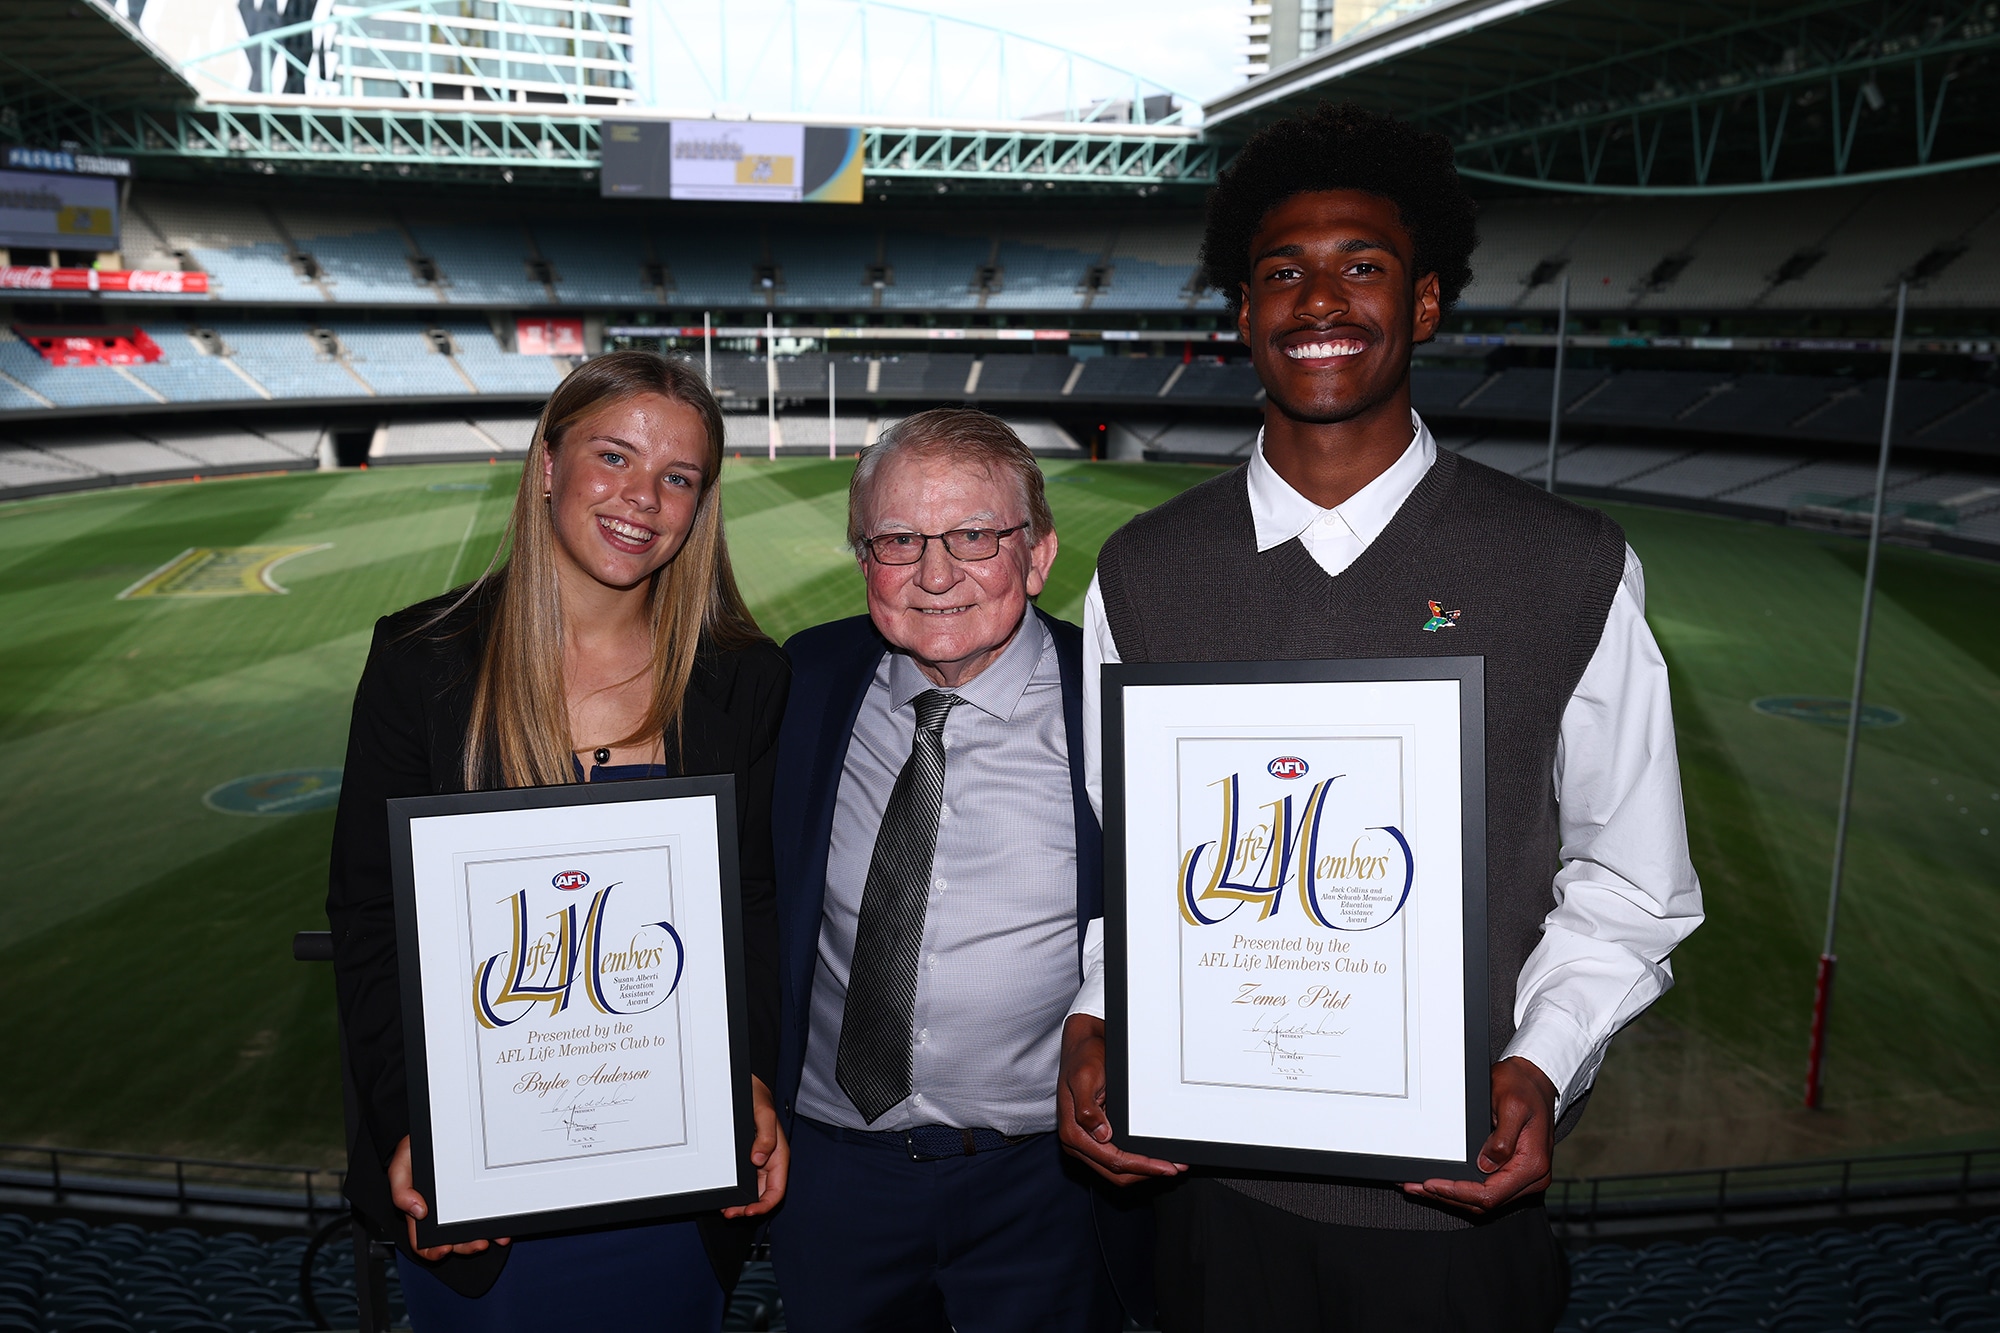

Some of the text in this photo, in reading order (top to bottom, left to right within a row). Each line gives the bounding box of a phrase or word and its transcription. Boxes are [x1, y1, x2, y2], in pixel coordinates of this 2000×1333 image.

[1270, 761, 1306, 775] AFL
[555, 874, 588, 887] AFL
[1346, 886, 1369, 894] Collins
[1231, 934, 1350, 955] Presented by the
[1198, 952, 1388, 974] AFL Life Members Club to
[613, 973, 659, 984] Susan Alberti
[619, 982, 654, 991] Education
[619, 990, 655, 999] Assistance
[626, 997, 649, 1006] Award
[1231, 982, 1352, 1010] Zemes Pilot
[527, 1022, 633, 1044] Presented by the
[496, 1036, 665, 1064] AFL Life Members Club to
[512, 1070, 571, 1098] Brylee
[576, 1063, 652, 1086] Anderson
